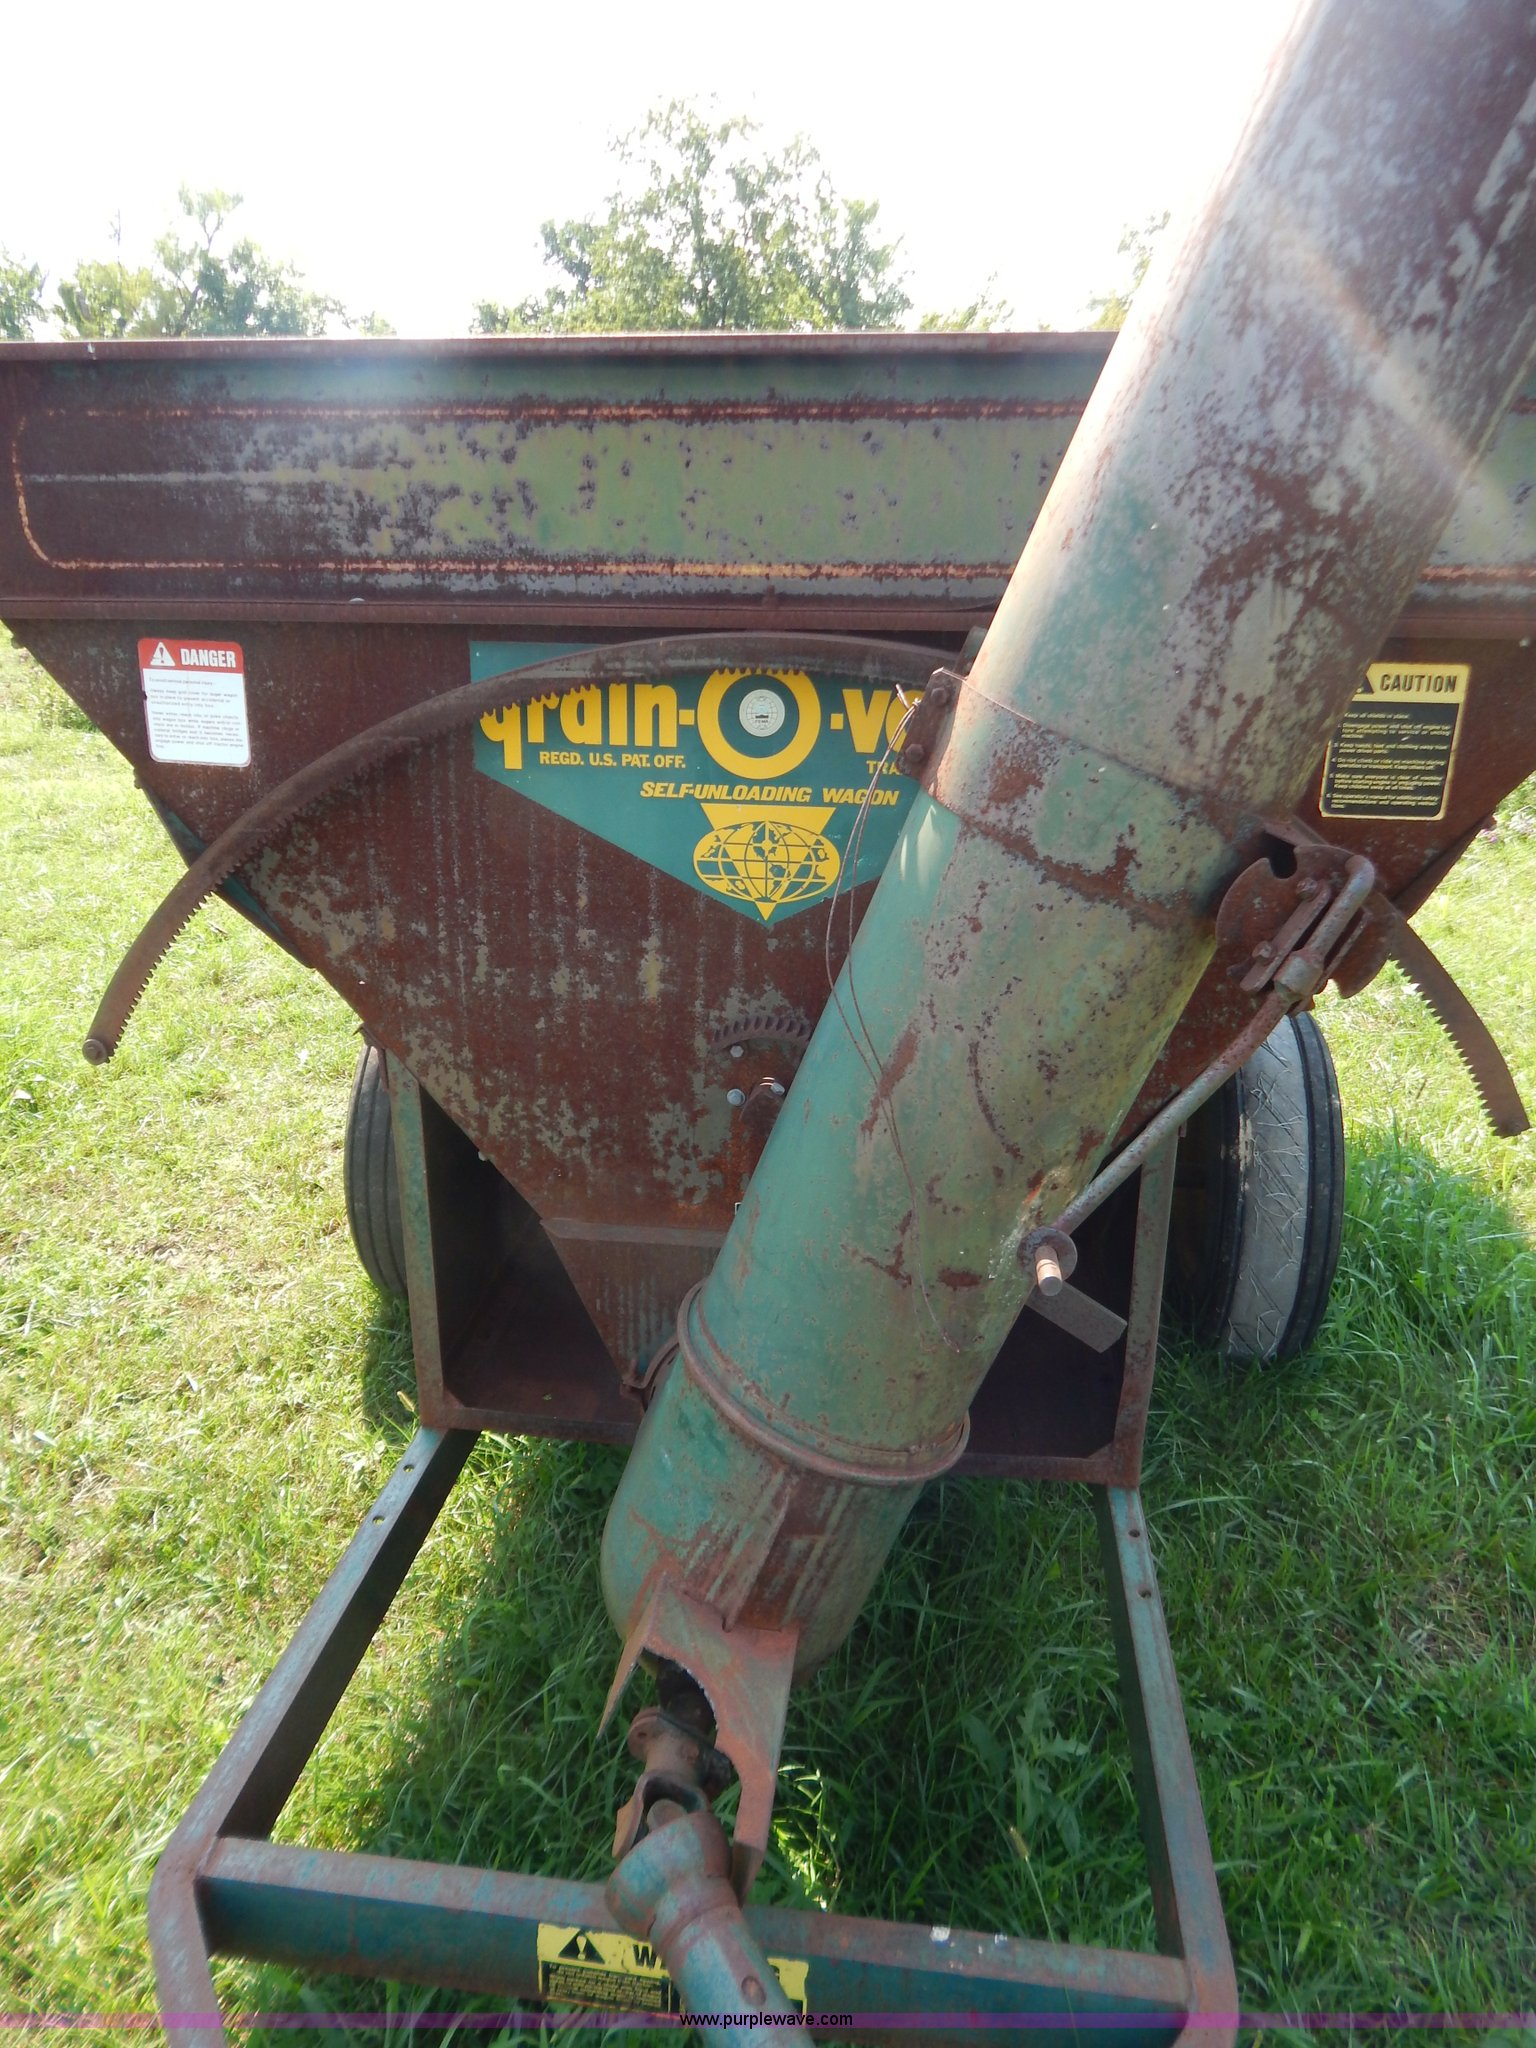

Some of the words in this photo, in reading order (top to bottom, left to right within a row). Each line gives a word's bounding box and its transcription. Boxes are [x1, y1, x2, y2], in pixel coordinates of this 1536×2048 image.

[180, 648, 237, 668] DANGER
[1380, 674, 1457, 693] CAUTION
[540, 751, 584, 765] REGD.
[589, 753, 617, 767] U.S.
[622, 754, 650, 767] PAT.
[654, 755, 686, 769] OFF.
[866, 760, 902, 775] TRA
[640, 782, 812, 802] SELF-UNLOADING
[822, 788, 900, 806] WAGON
